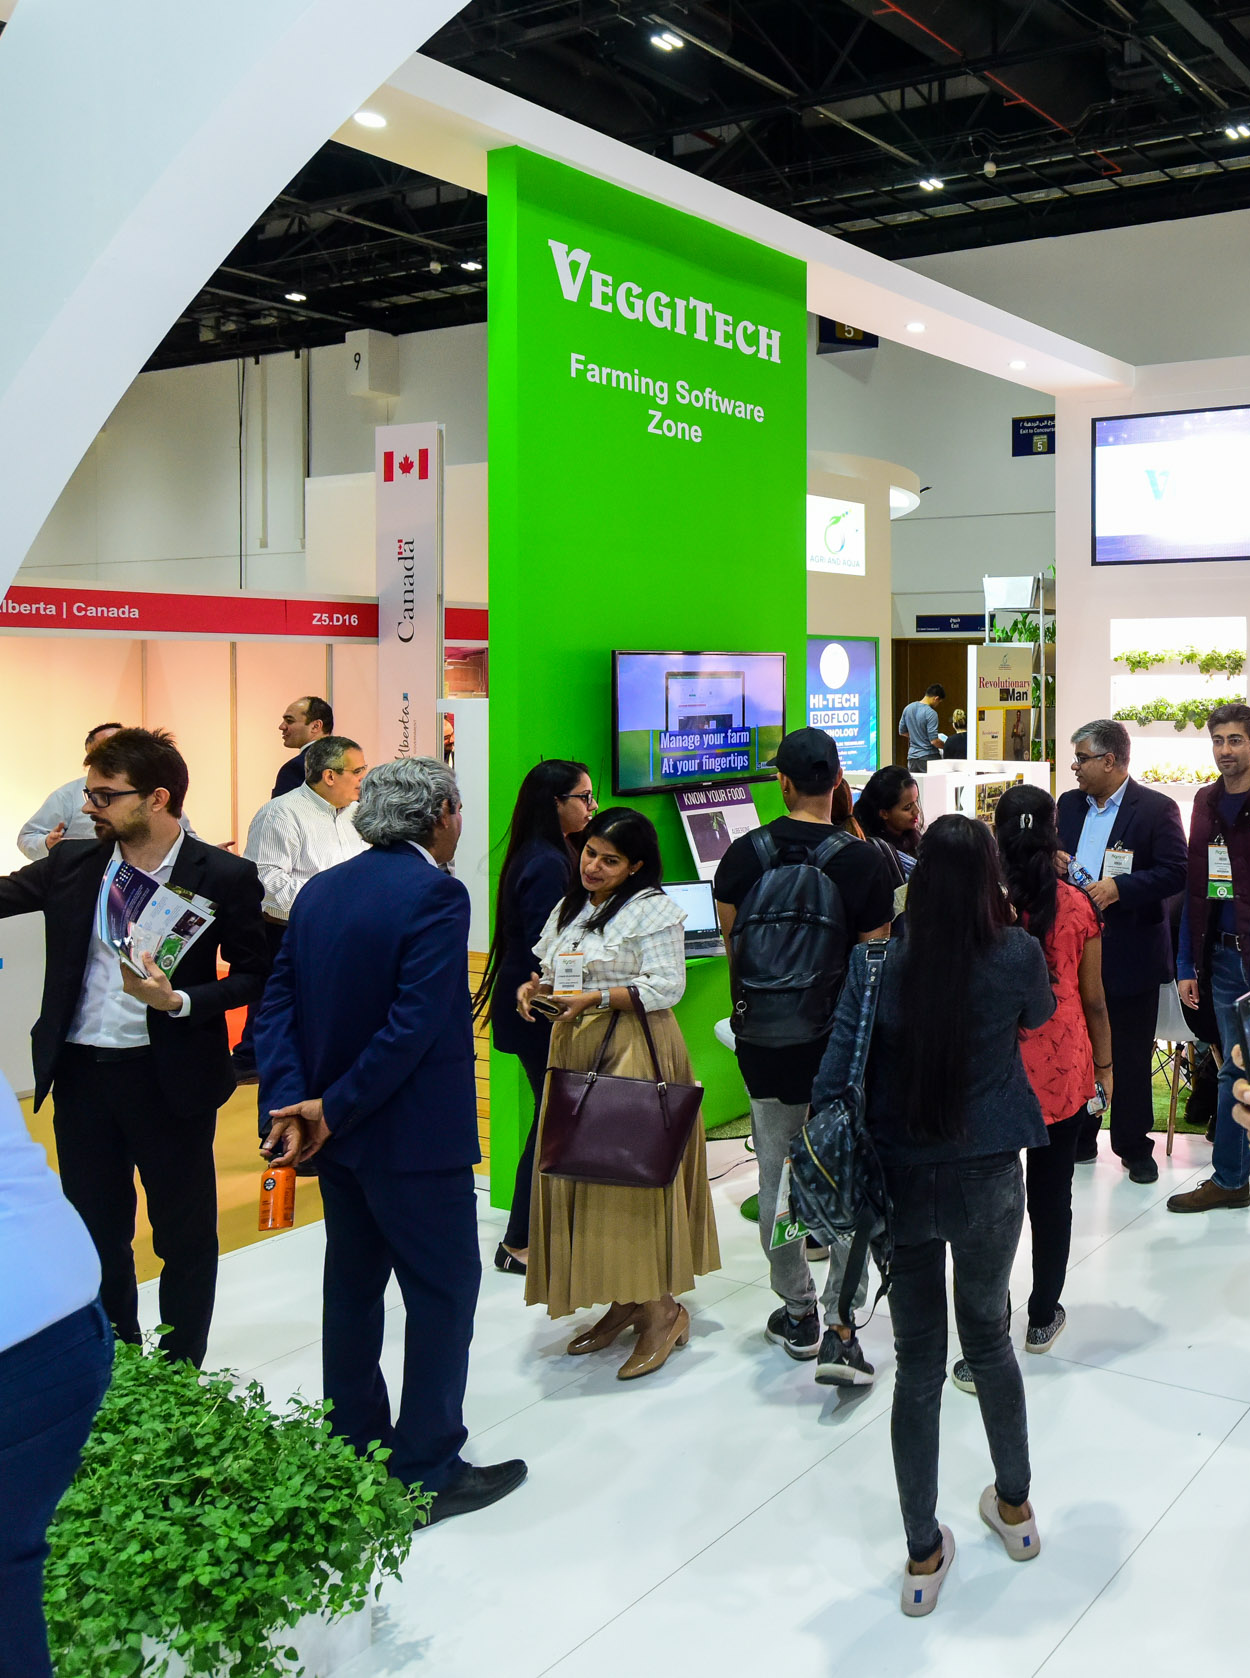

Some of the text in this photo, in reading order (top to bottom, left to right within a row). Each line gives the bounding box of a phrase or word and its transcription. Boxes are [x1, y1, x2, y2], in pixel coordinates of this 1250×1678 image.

[548, 239, 781, 363] VEGGITECH
[354, 352, 361, 371] 9
[570, 353, 764, 423] Farming Software
[647, 410, 702, 443] Zone
[1037, 441, 1043, 451] 5
[397, 538, 415, 643] Canada
[0, 600, 56, 615] lberta
[73, 602, 139, 619] Canada
[312, 613, 358, 627] Z5.D16
[979, 677, 1031, 690] Revolutionary
[810, 694, 859, 708] HI-TECH
[1008, 688, 1028, 701] Man
[812, 713, 856, 724] BIOFLOC
[661, 729, 749, 749] Manage your farm
[662, 754, 748, 775] At your fingertips
[683, 787, 746, 805] KNOW YOUR FOOD
